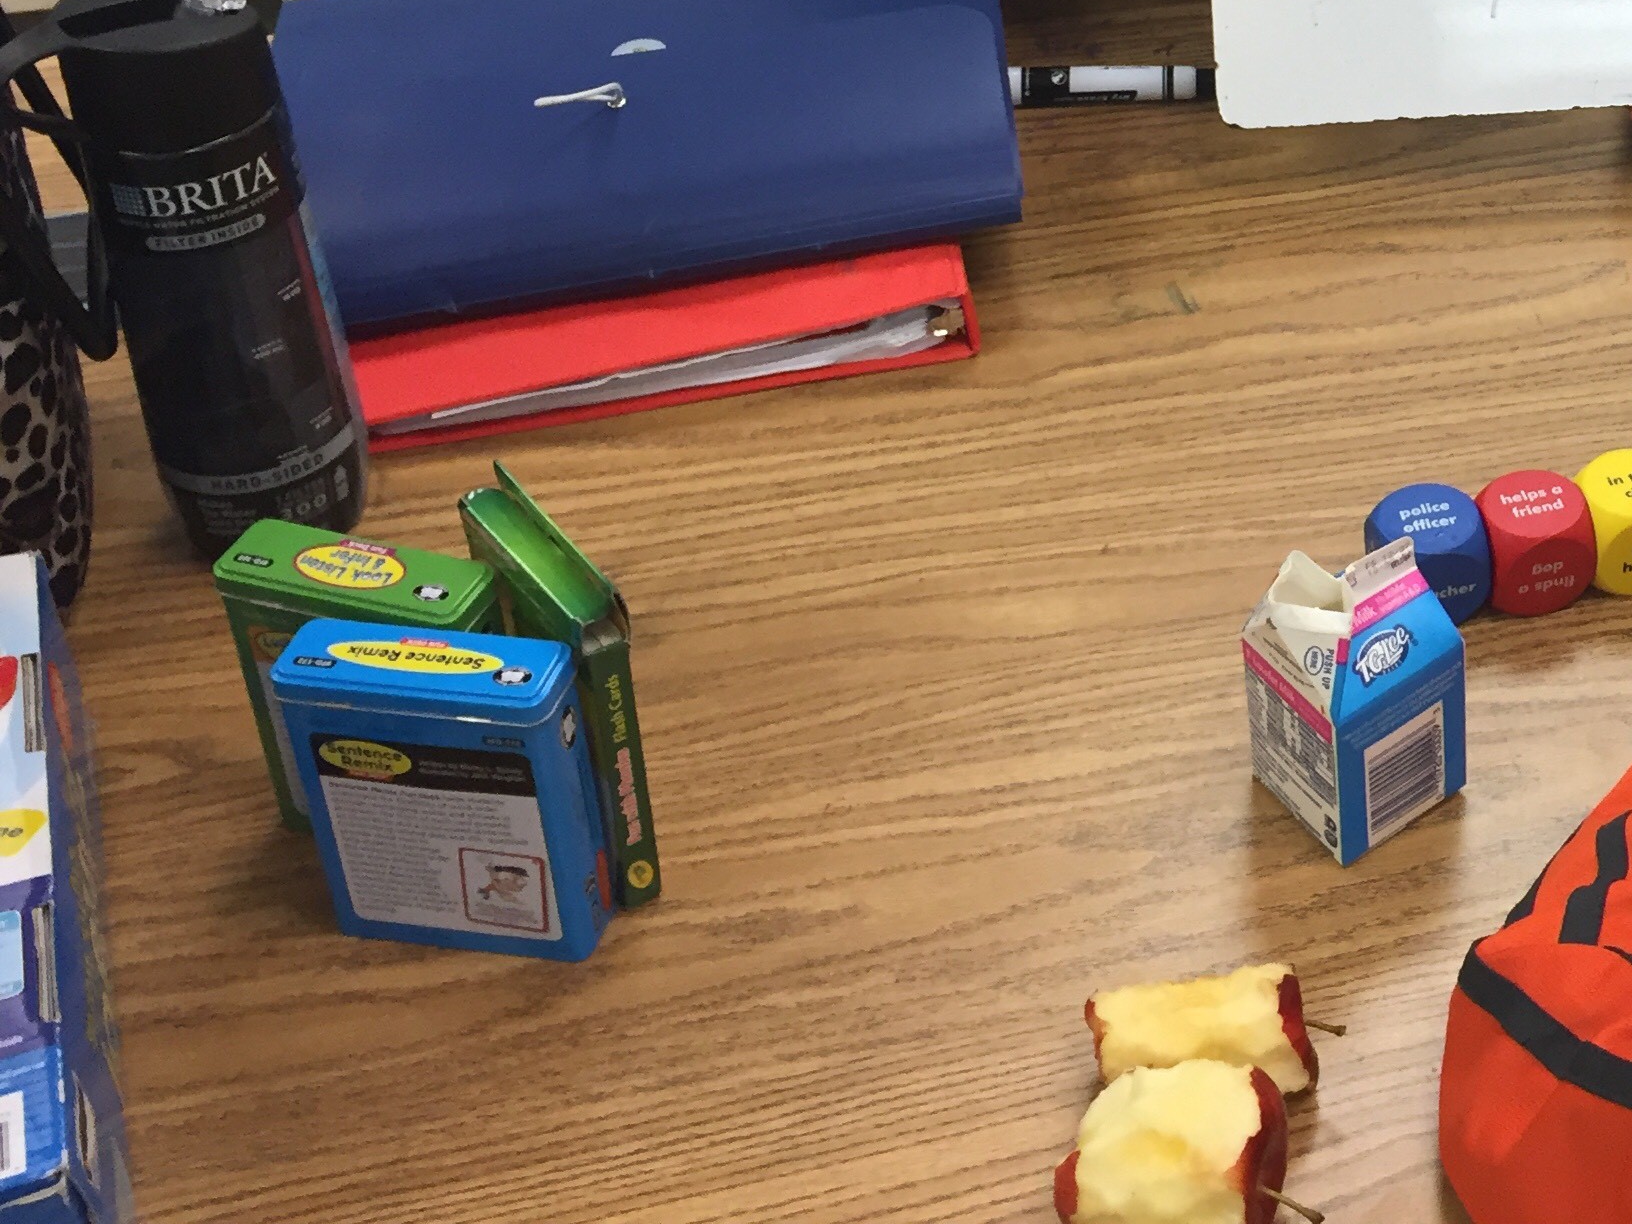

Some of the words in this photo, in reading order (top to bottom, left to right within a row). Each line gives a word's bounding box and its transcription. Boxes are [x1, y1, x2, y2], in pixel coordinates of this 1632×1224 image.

[142, 156, 277, 218] BRITA
[1606, 475, 1624, 487] in
[1499, 488, 1547, 506] helps
[1551, 485, 1564, 496] a
[1399, 500, 1450, 521] police
[1512, 498, 1565, 519] friend
[1403, 513, 1457, 533] officer
[351, 569, 394, 586] Look
[1532, 560, 1565, 576] dog
[1434, 582, 1477, 599] cher
[1518, 584, 1530, 595] a
[1534, 574, 1575, 591] finds
[346, 645, 402, 662] Remix
[404, 651, 486, 670] Sentence
[1323, 647, 1335, 676] PUSH
[605, 673, 622, 711] Cards
[1321, 676, 1331, 691] UP
[610, 710, 627, 744] Flash
[326, 741, 402, 762] Sentence
[340, 754, 394, 772] Remix
